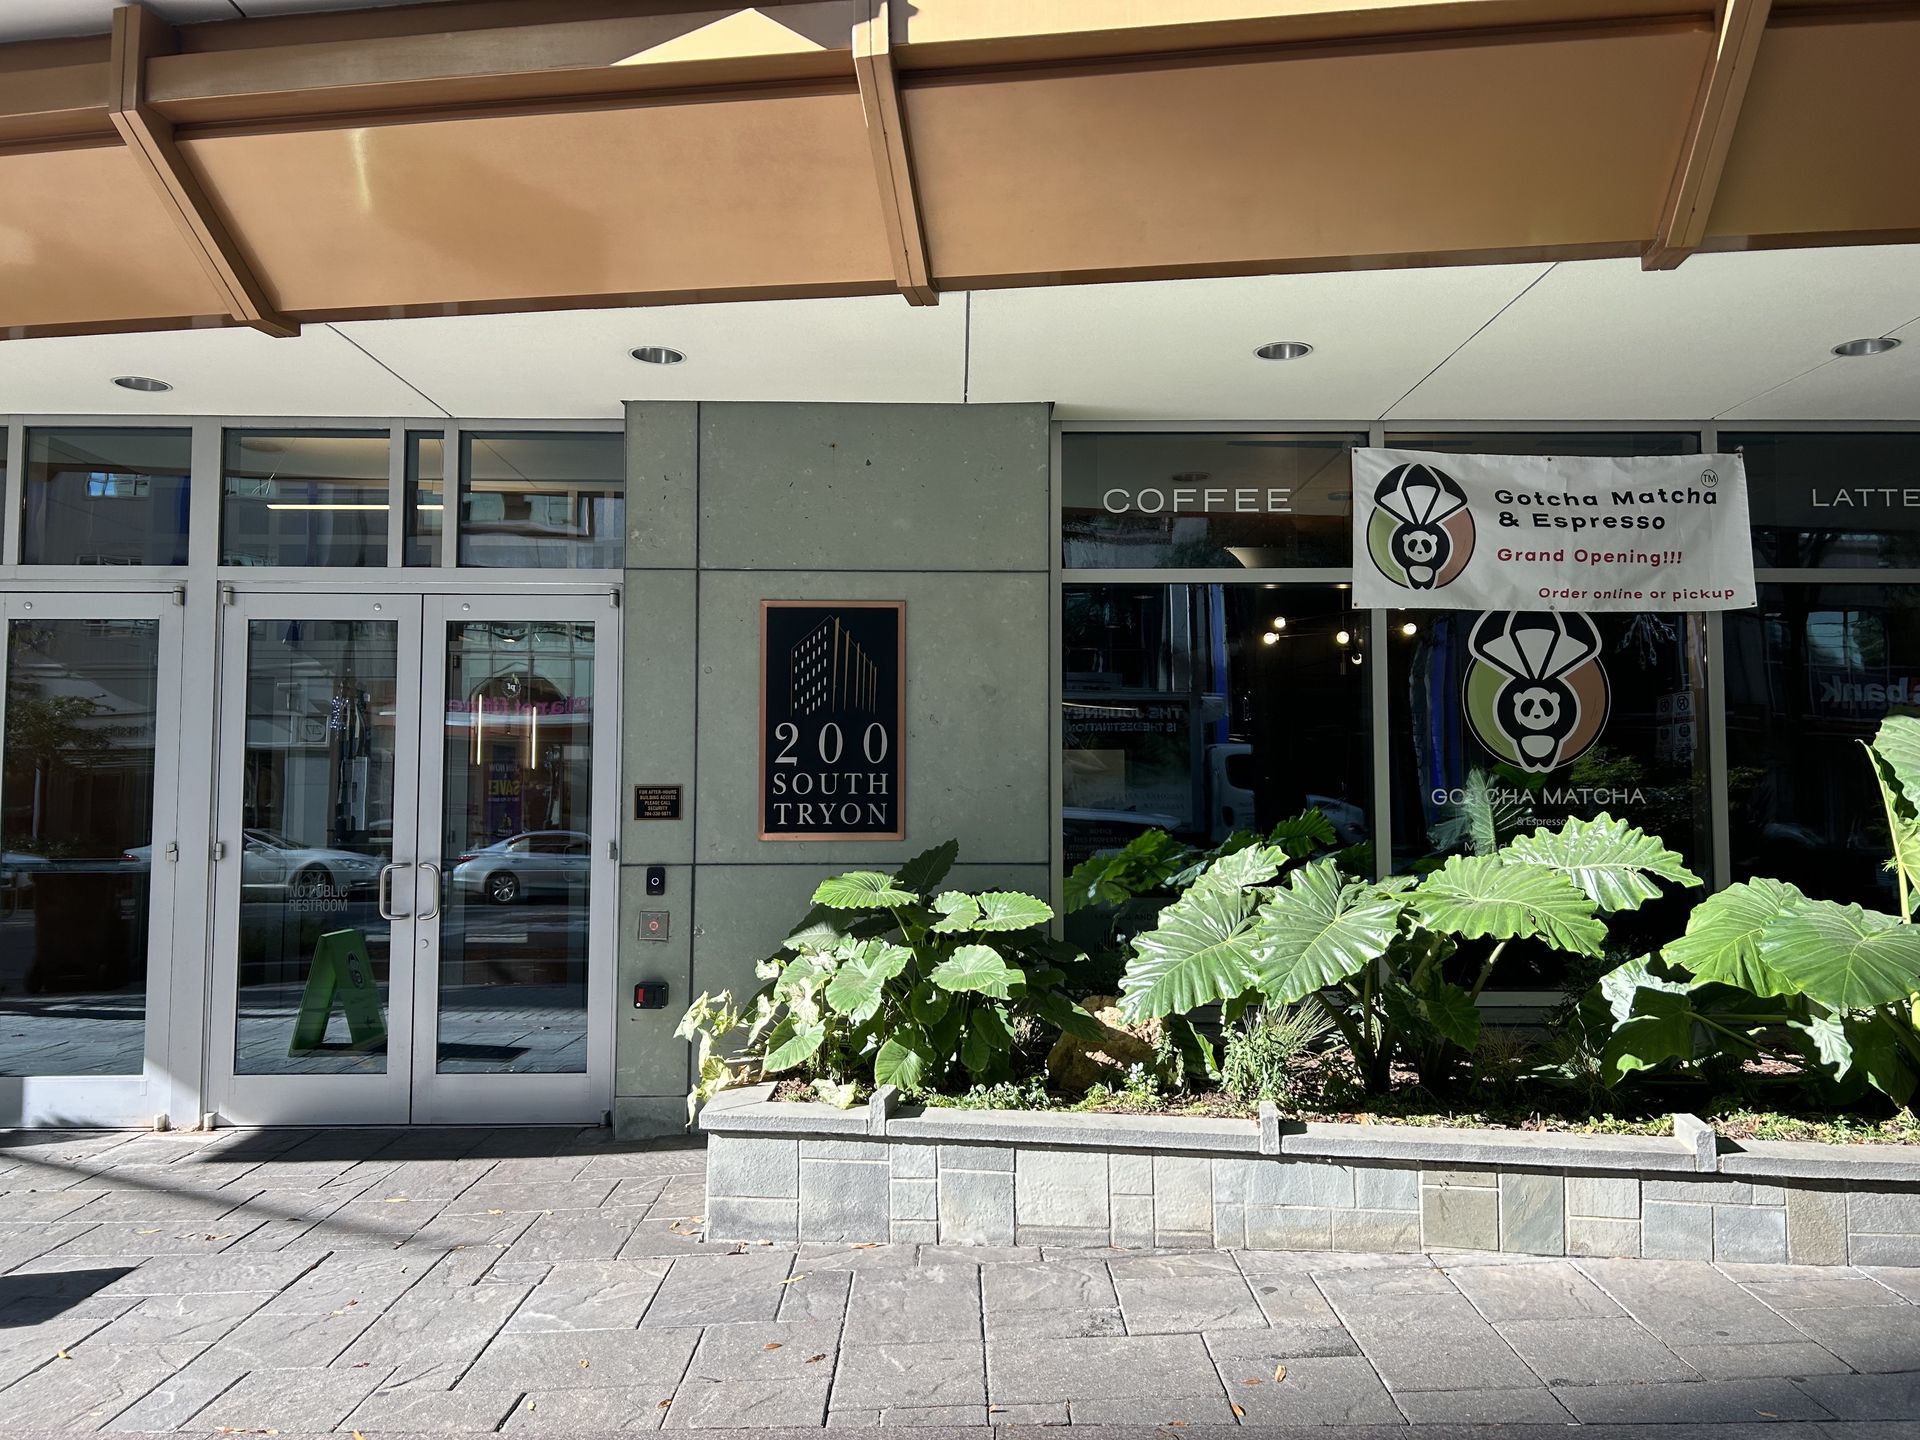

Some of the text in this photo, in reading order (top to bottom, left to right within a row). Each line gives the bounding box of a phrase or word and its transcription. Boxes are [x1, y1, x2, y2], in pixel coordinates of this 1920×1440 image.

[1102, 488, 1293, 514] COFFEE
[1494, 487, 1717, 507] Gotcha Matcha
[1812, 488, 1920, 507] LATTE
[1498, 512, 1666, 533] & Espresso
[1497, 548, 1683, 567] Grand Opening!!!
[1538, 587, 1735, 602] Order online or pickup
[774, 722, 888, 766] 200
[772, 772, 889, 795] SOUTH
[1431, 787, 1647, 806] GOCHA MATCHA
[773, 802, 888, 825] TRYON
[1516, 816, 1567, 828] & Espresso
[289, 884, 348, 898] NO PUBLIC
[288, 899, 348, 912] RESTROOM
